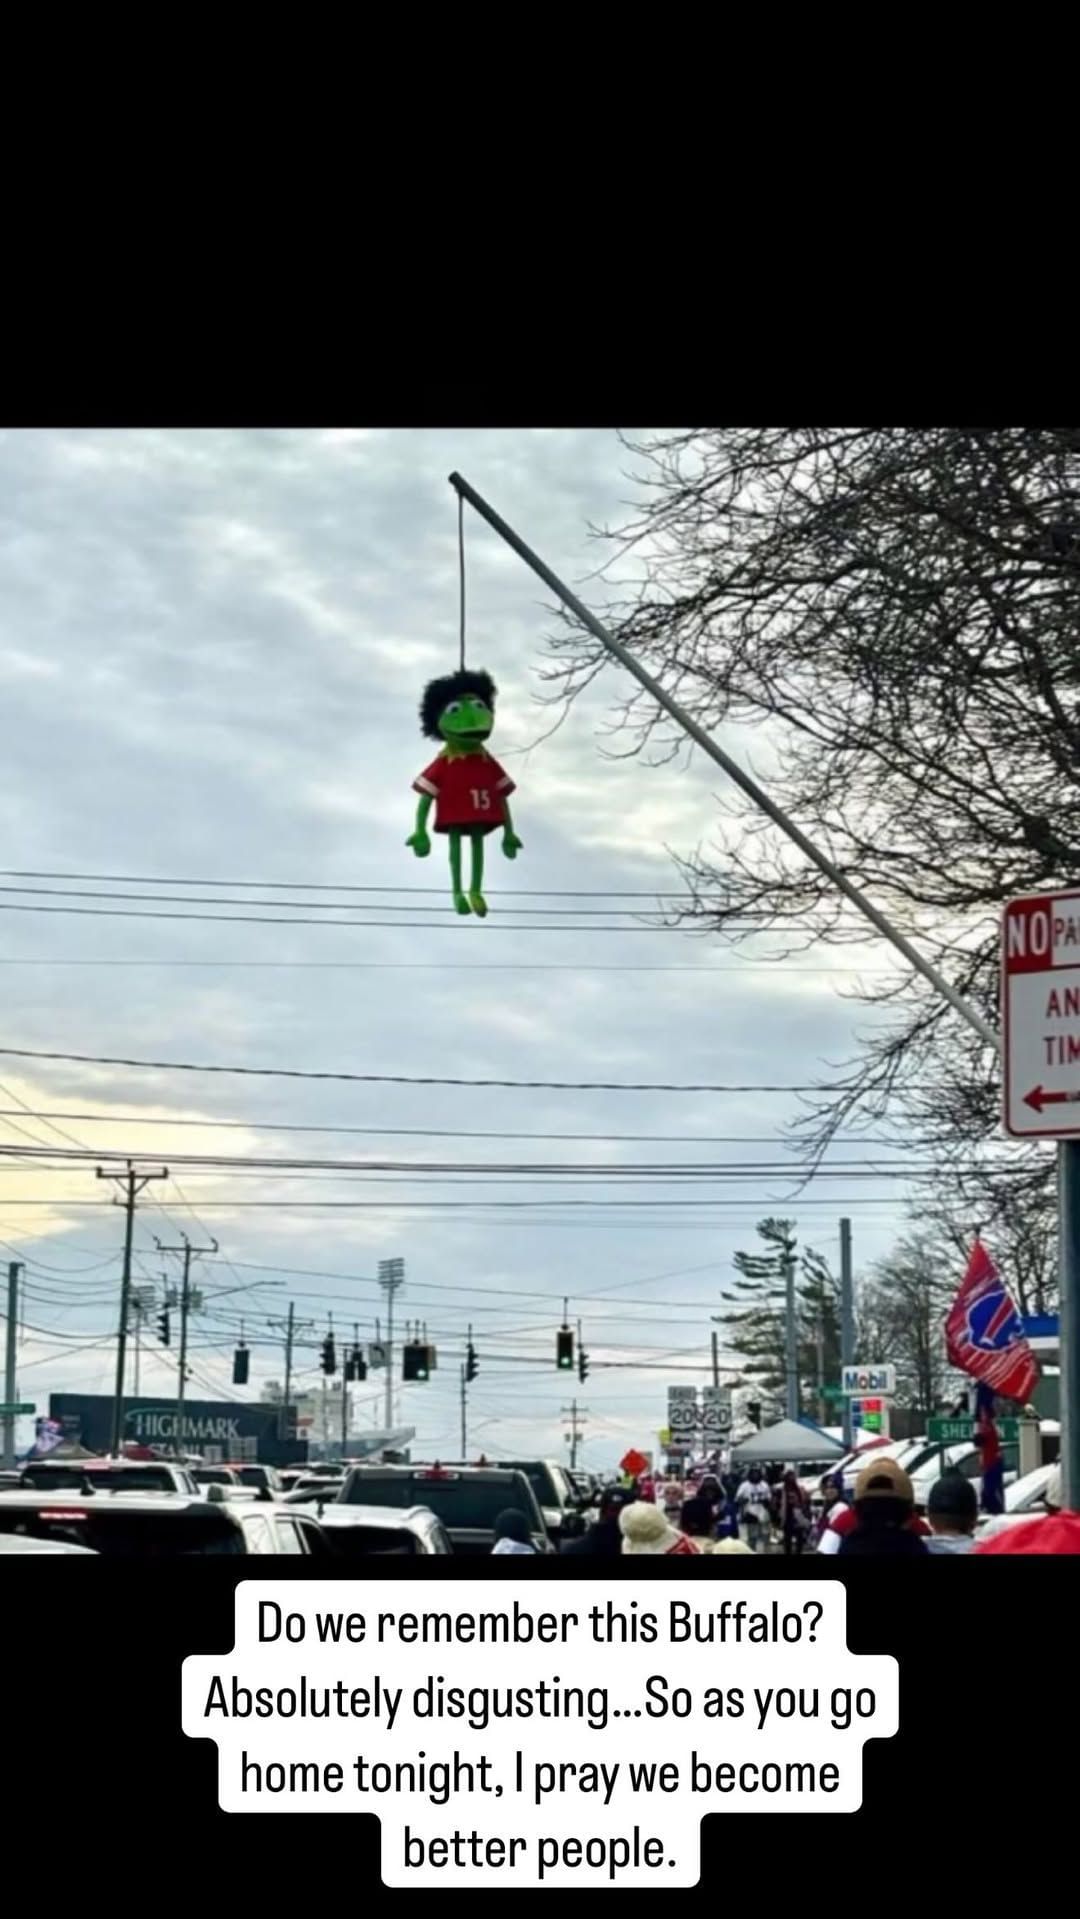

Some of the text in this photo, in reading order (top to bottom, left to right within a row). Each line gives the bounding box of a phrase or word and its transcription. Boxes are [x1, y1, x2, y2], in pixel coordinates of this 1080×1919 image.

[470, 788, 490, 809] 15
[1009, 911, 1080, 957] NO PA
[845, 1370, 888, 1390] Mobil
[671, 1407, 693, 1425] 20
[706, 1407, 728, 1425] 20
[136, 1414, 240, 1441] HIGHMARK
